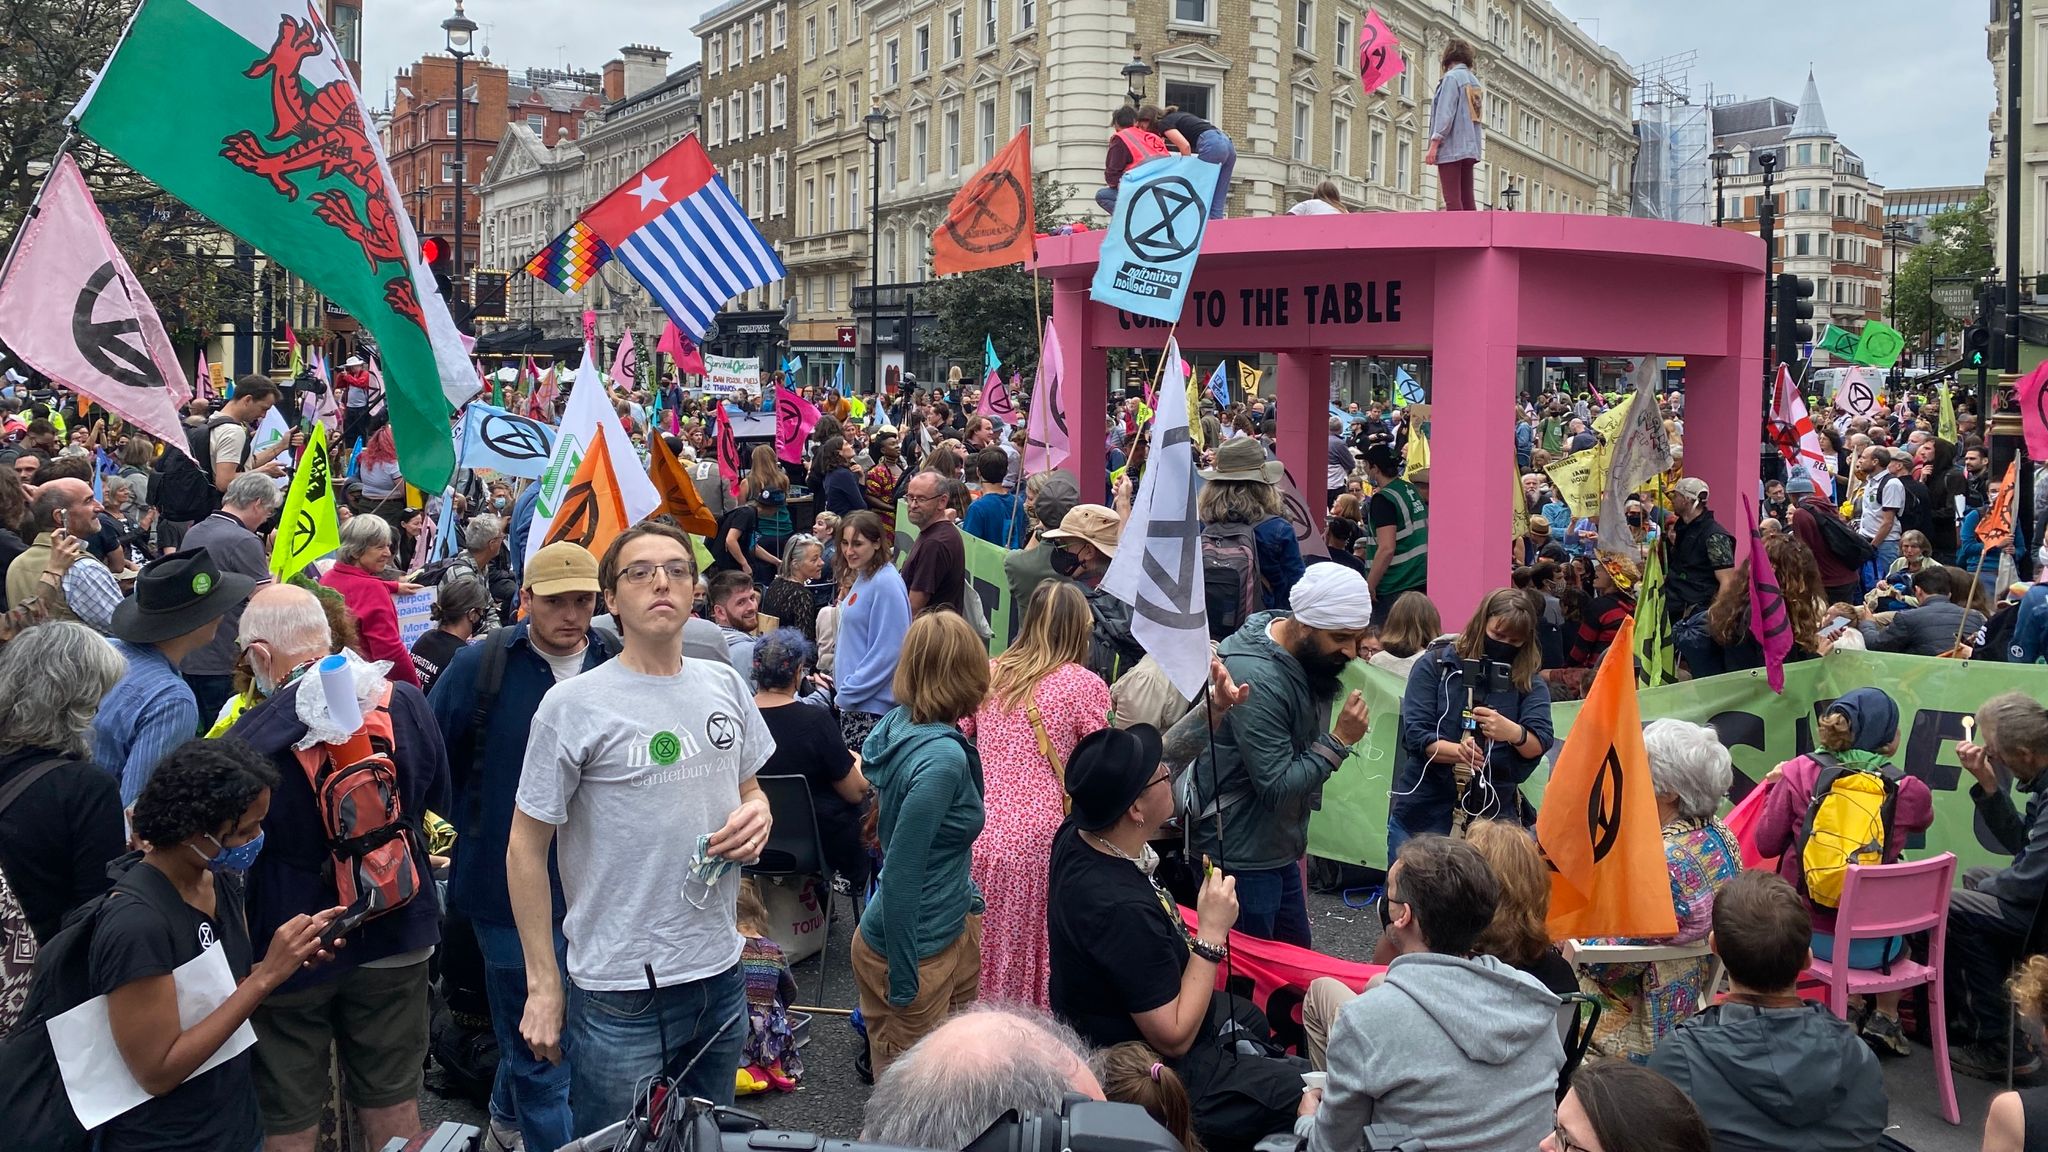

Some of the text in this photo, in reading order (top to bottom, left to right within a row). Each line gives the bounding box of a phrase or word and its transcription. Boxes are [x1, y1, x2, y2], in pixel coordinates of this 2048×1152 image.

[1193, 290, 1225, 327] TO
[1240, 287, 1289, 326] THE
[1304, 280, 1401, 325] TABLE
[705, 356, 759, 374] Survival Options
[713, 375, 725, 383] BAN
[726, 376, 743, 384] FOSSIL
[713, 384, 737, 392] THANOS
[397, 592, 432, 605] Airport
[403, 621, 430, 632] More
[631, 763, 713, 788] Canterbury
